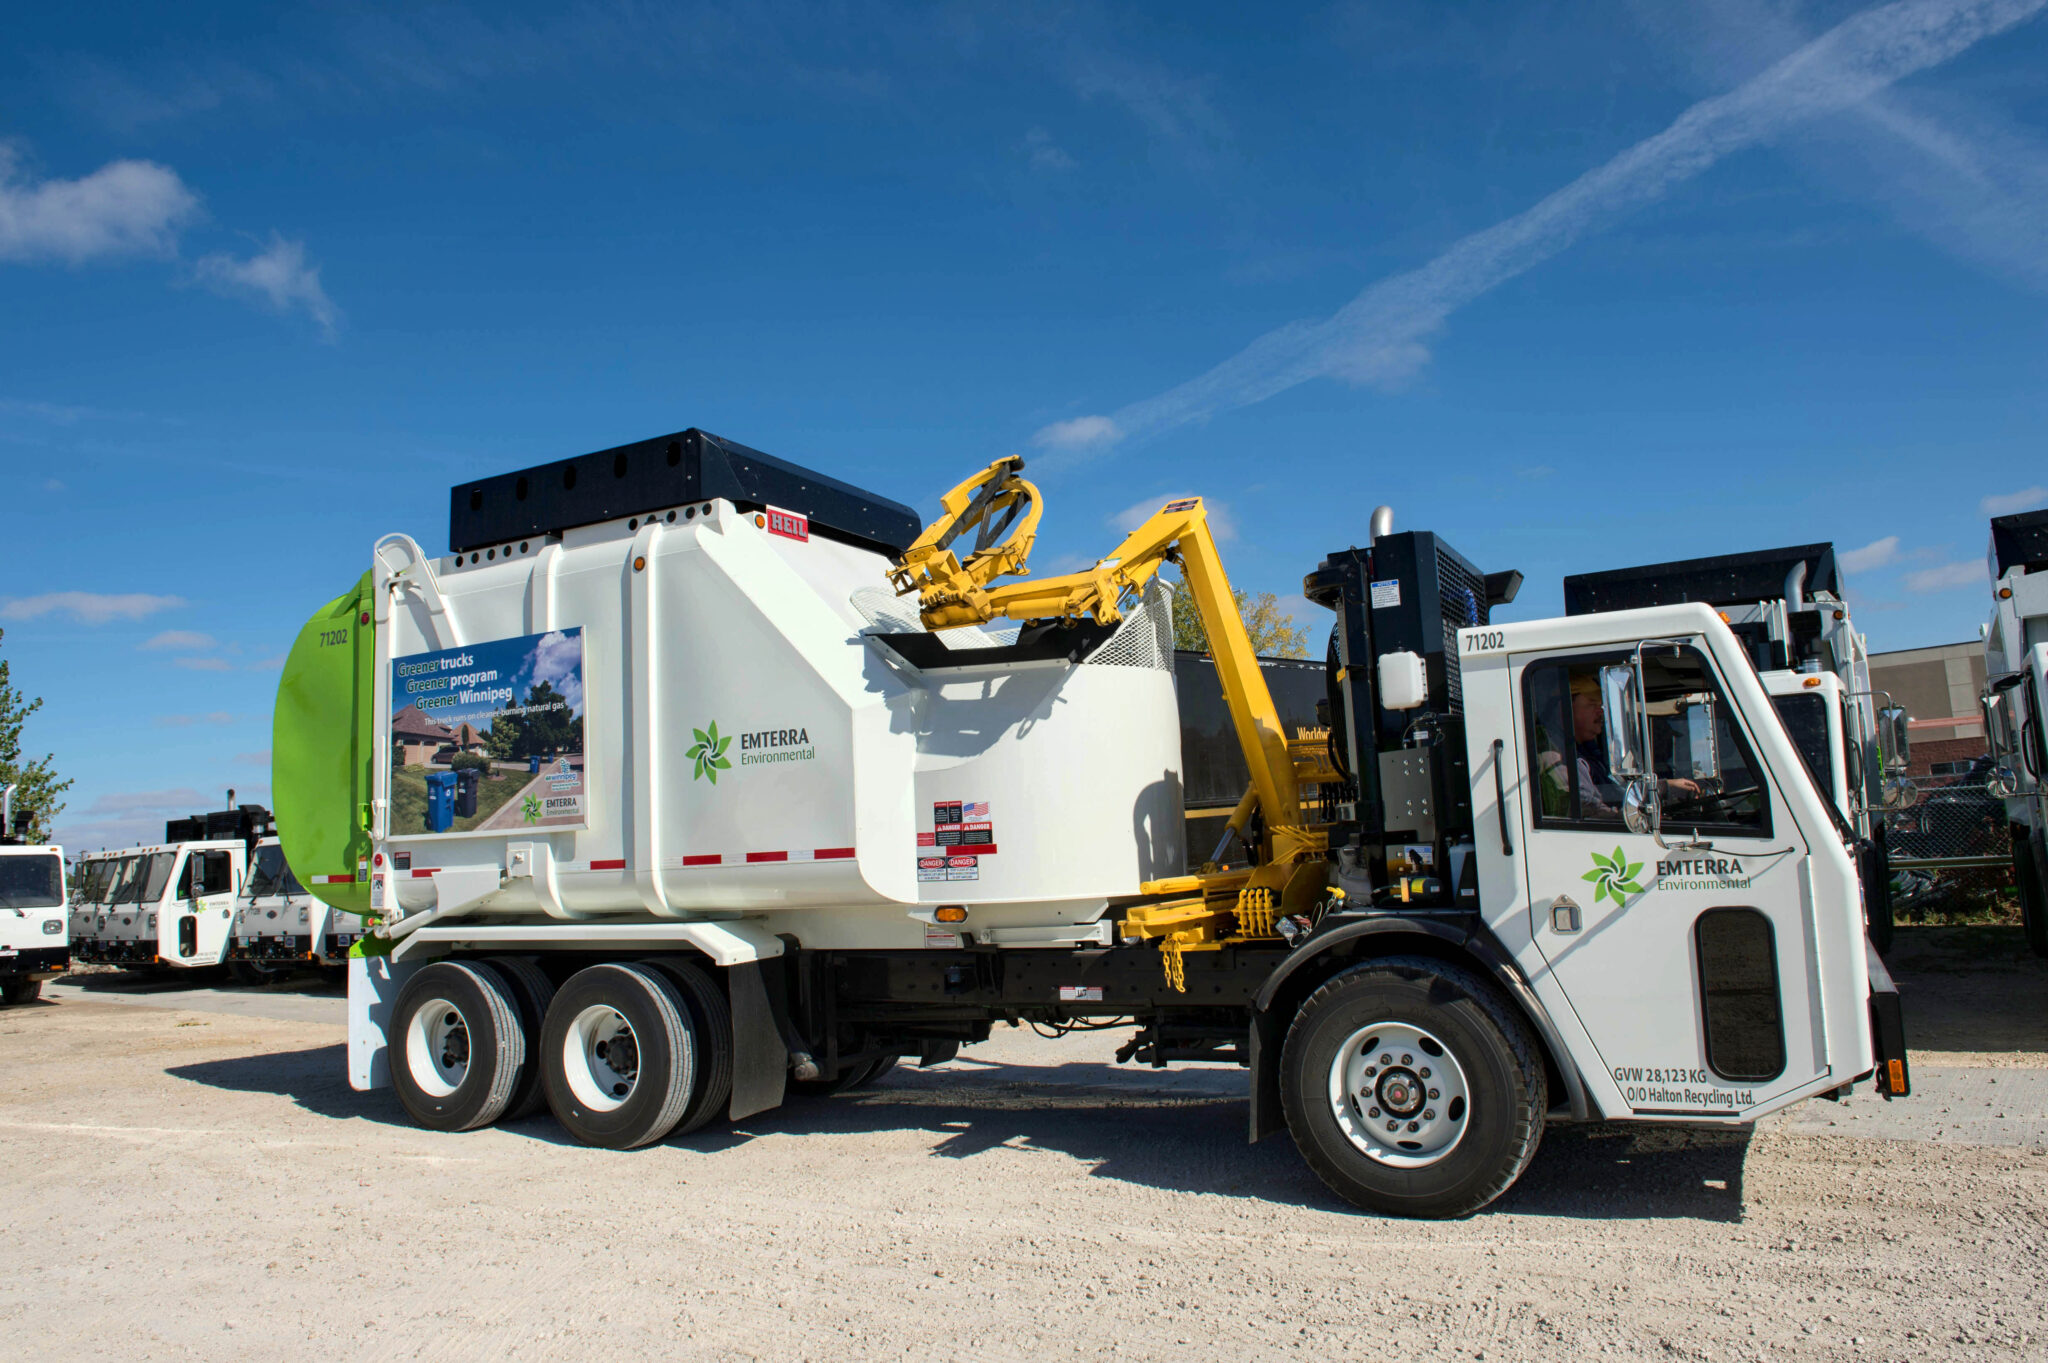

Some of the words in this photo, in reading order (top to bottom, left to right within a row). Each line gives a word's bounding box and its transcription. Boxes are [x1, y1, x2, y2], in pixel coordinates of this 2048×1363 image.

[771, 513, 807, 538] HEIL
[320, 629, 348, 648] 71202
[1466, 631, 1504, 651] 71202
[399, 661, 439, 677] Greener
[440, 653, 474, 670] trucks
[407, 676, 449, 693] Greener
[450, 670, 498, 690] program
[415, 695, 458, 710] Greener
[459, 687, 513, 704] Winnipeg
[527, 702, 552, 712] natural
[552, 702, 565, 712] gas
[741, 728, 809, 750] EMTERRA
[741, 746, 815, 765] Environmental
[546, 797, 577, 809] EMTERRA
[546, 807, 580, 816] Environmental
[920, 860, 943, 868] DANGER
[950, 858, 974, 866] DANGER
[1656, 858, 1743, 876] EMTERRA
[1657, 876, 1751, 891] Environmental
[1614, 1067, 1643, 1082] GVW
[1645, 1069, 1687, 1084] 28,123
[1689, 1069, 1707, 1083] KG
[1649, 1087, 1682, 1102] Halton
[1684, 1088, 1734, 1108] Recycling
[1735, 1090, 1756, 1105] Ltd.
